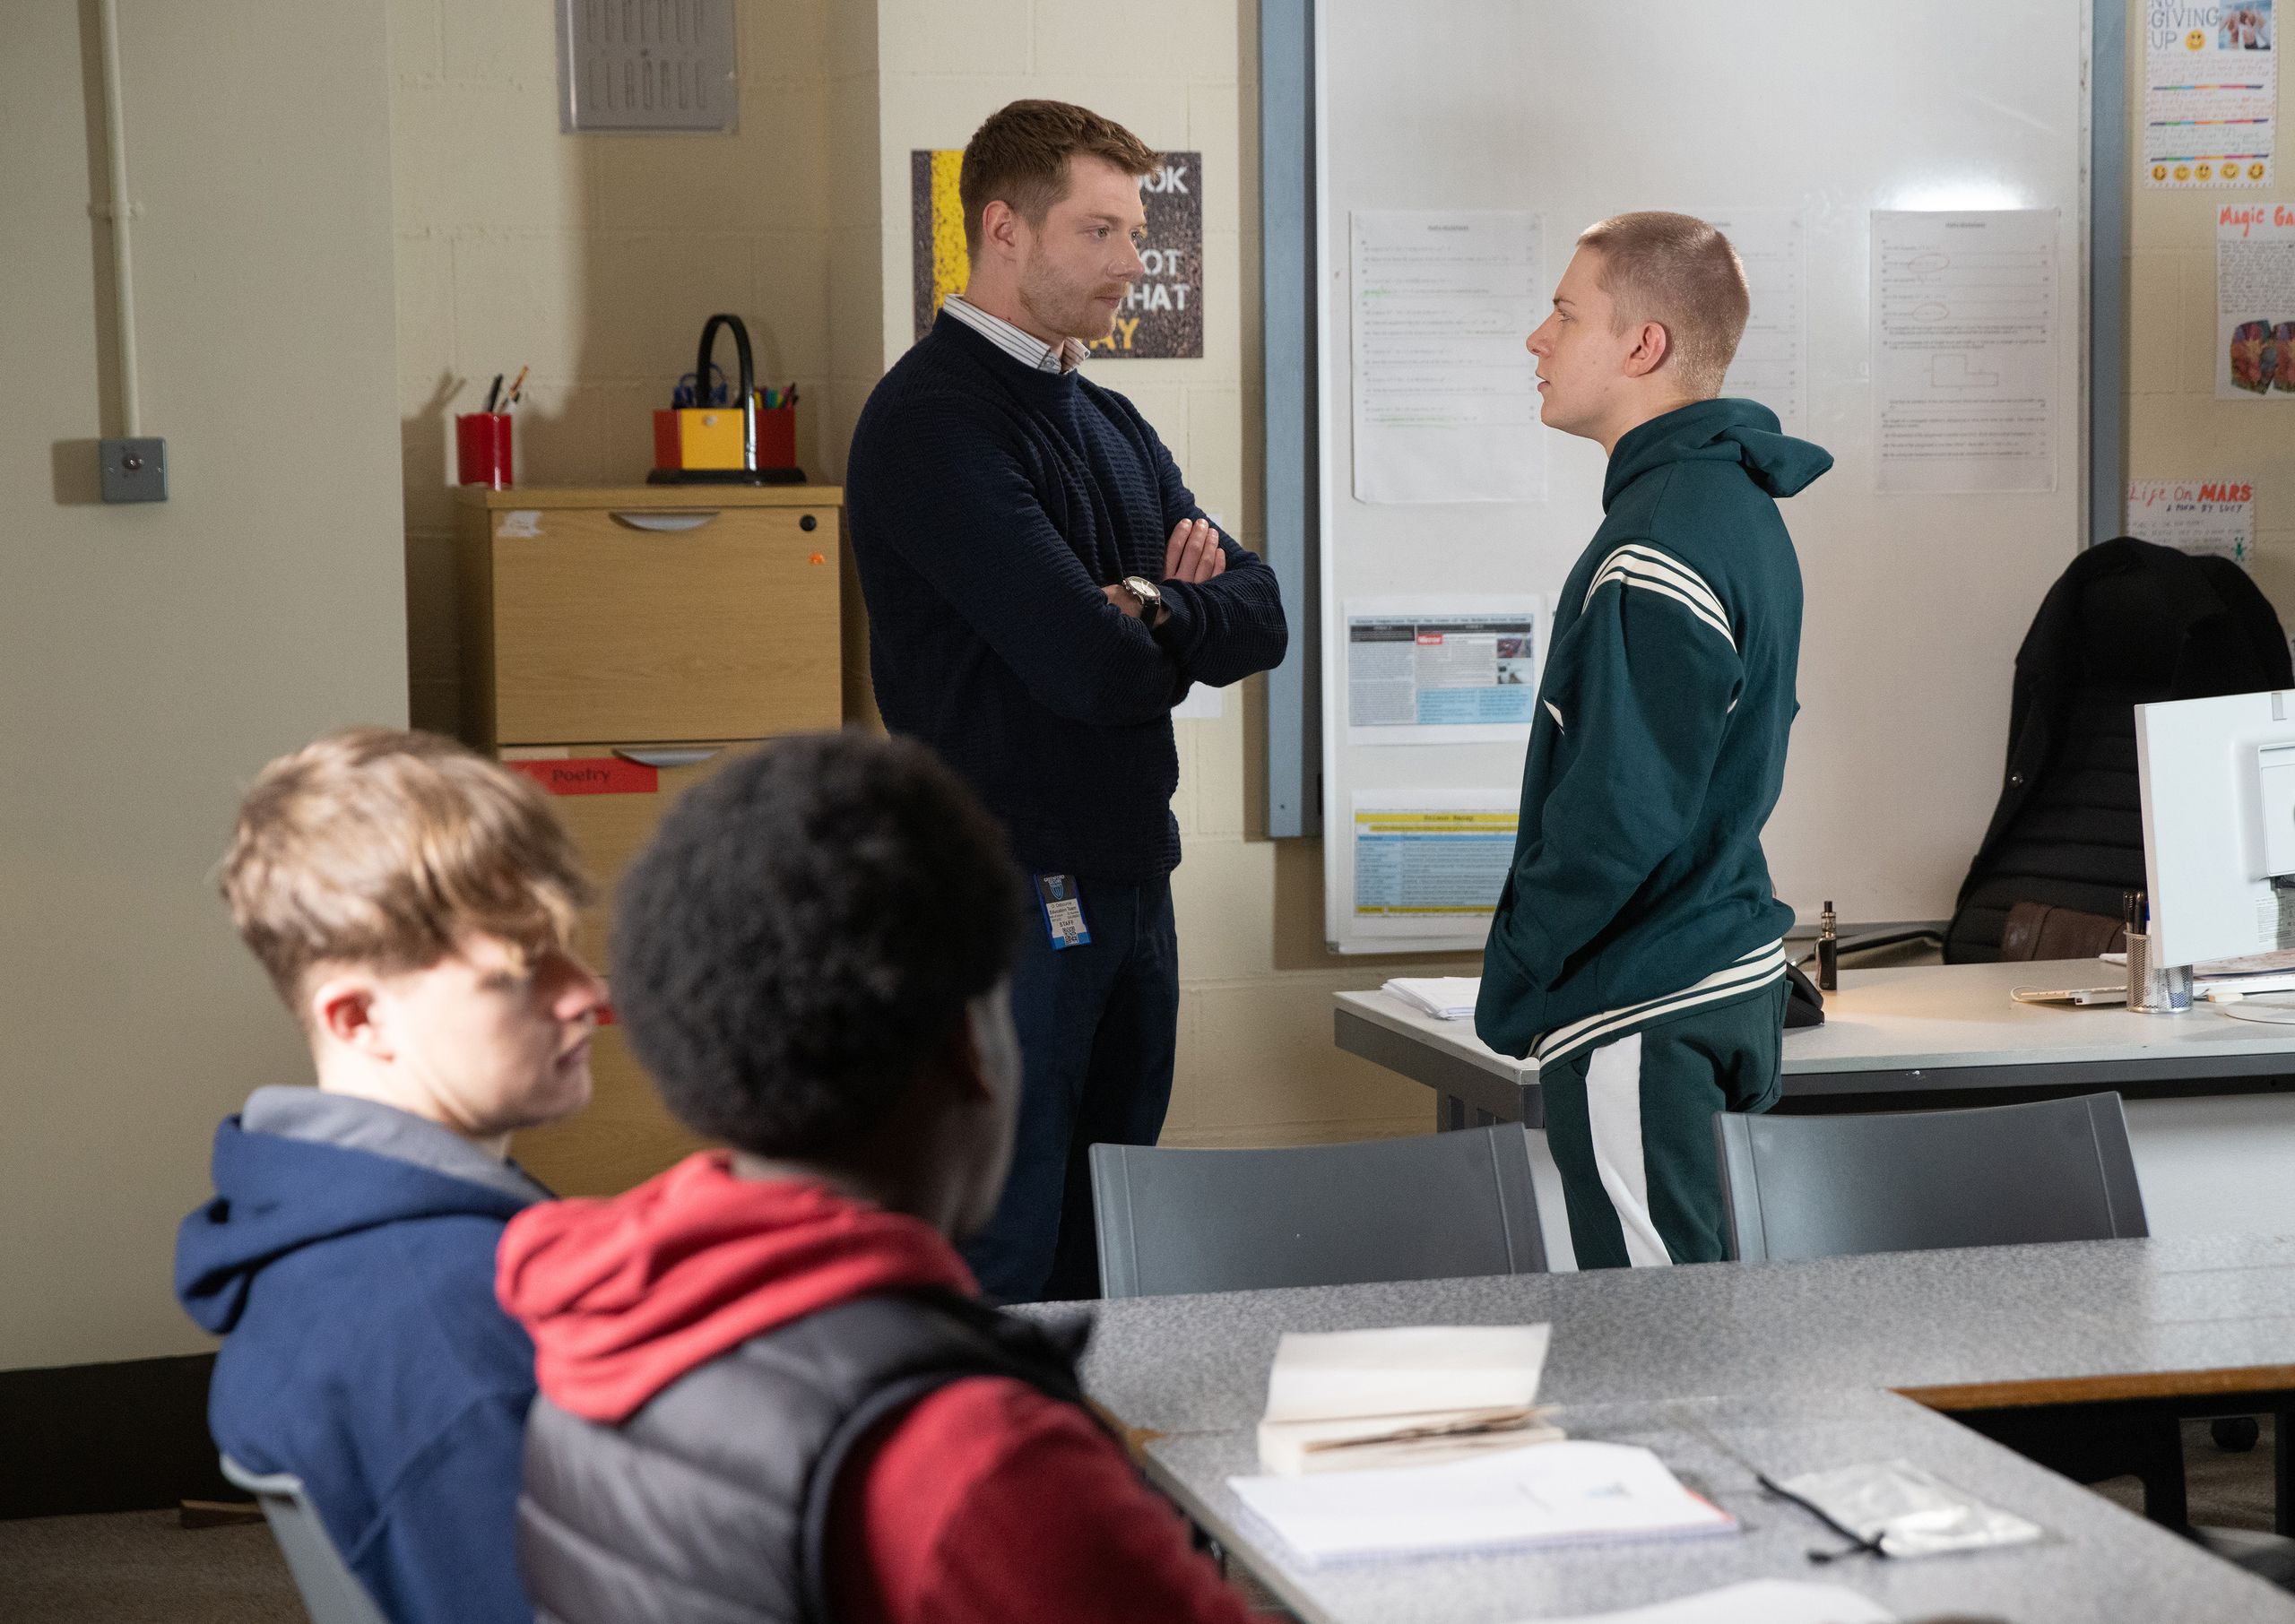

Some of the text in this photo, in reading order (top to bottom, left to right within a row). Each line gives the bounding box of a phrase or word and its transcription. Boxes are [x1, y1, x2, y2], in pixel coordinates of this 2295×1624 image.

[2151, 6, 2220, 30] GIVING
[2152, 30, 2178, 51] UP
[1138, 166, 1189, 194] OK
[1139, 248, 1182, 276] OT
[1120, 282, 1191, 311] HAT
[2196, 482, 2252, 503] MARS
[551, 767, 611, 783] Poetry
